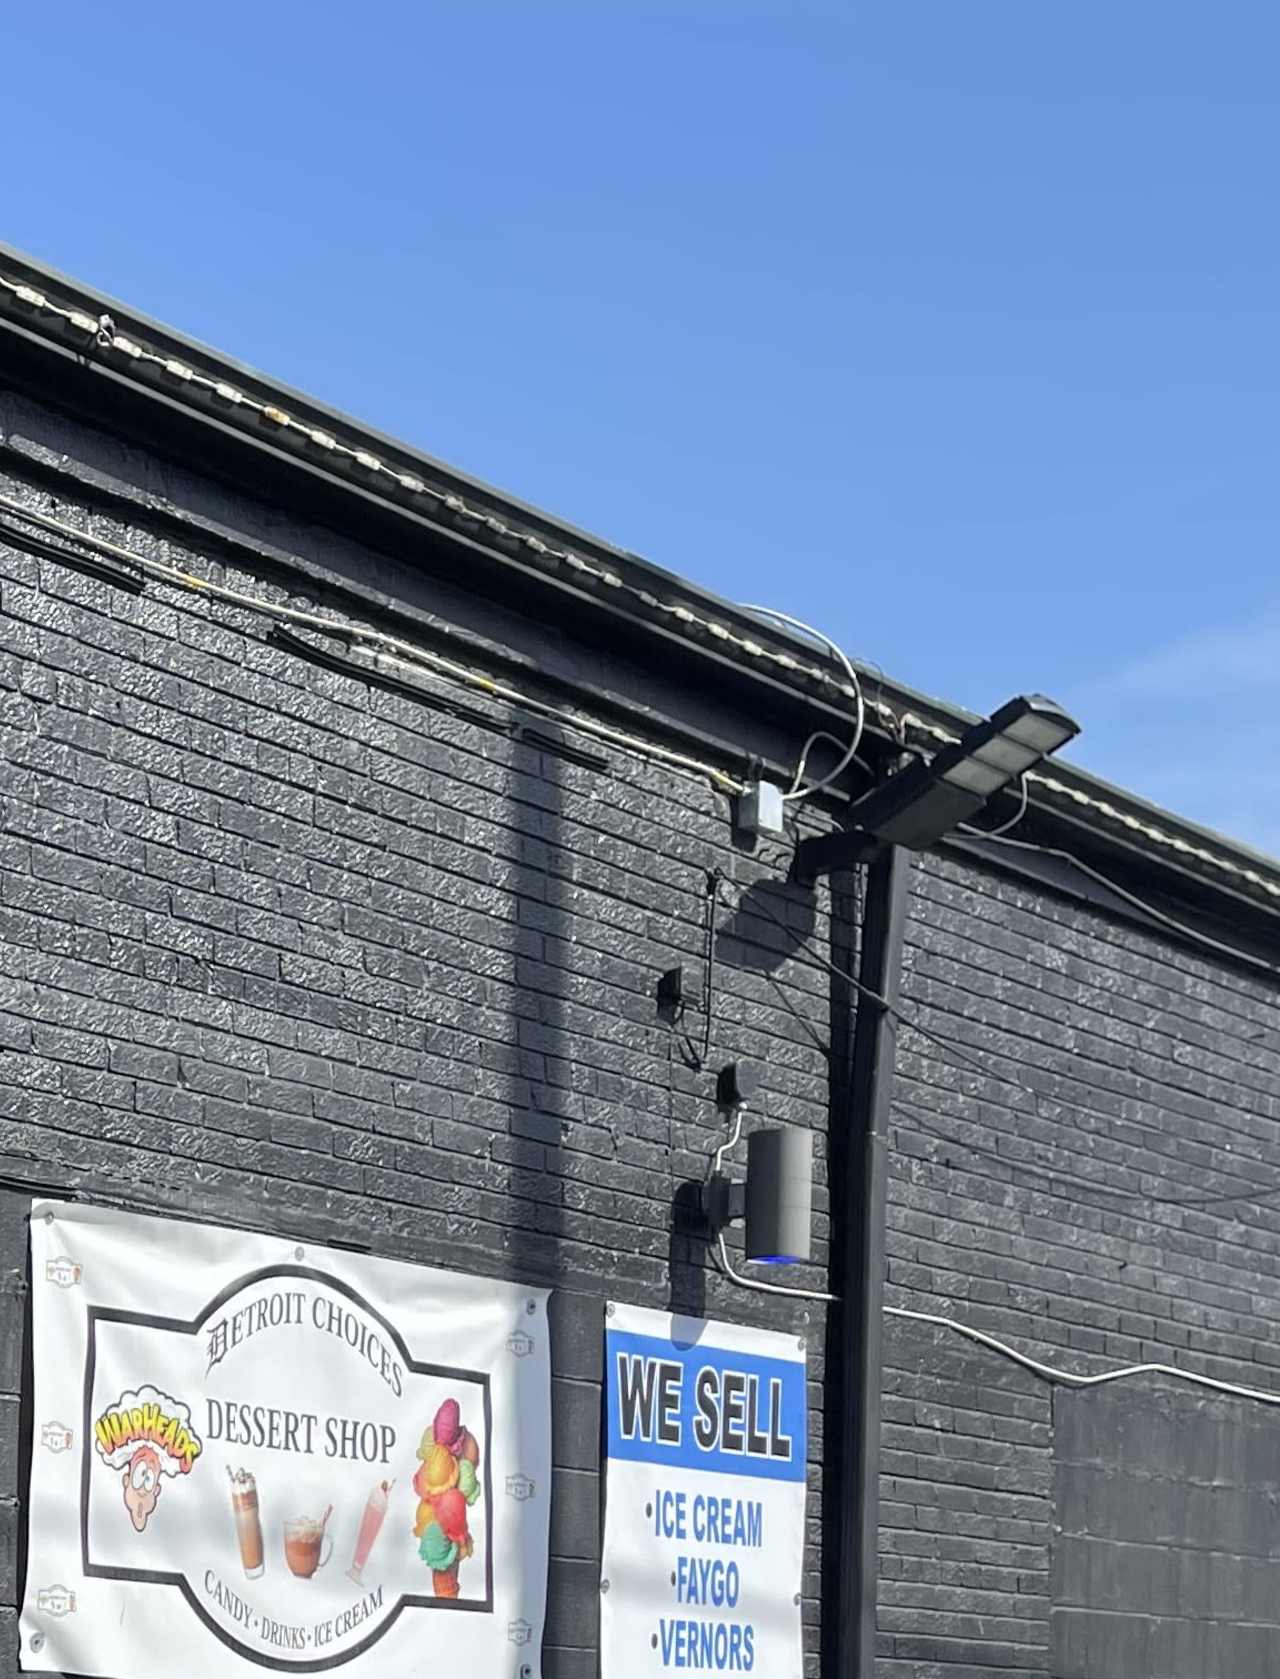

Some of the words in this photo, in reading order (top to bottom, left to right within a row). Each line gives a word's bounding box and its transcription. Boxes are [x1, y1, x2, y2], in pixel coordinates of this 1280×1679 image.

[204, 1292, 305, 1381] DETROIT
[312, 1297, 402, 1398] CHOICES
[95, 1402, 199, 1473] WARHEADS
[206, 1398, 317, 1455] DESSERT
[324, 1417, 396, 1464] SHOP
[616, 1352, 684, 1447] WE
[692, 1365, 792, 1462] SELL
[655, 1489, 687, 1540] ICE
[692, 1494, 763, 1548] CREAM
[204, 1569, 253, 1629] CANDY
[260, 1615, 305, 1649] DRINKS
[314, 1623, 332, 1647] ICE
[335, 1584, 384, 1637] CREAM
[676, 1556, 739, 1608] FAYGO
[659, 1619, 754, 1672] VERNORS
